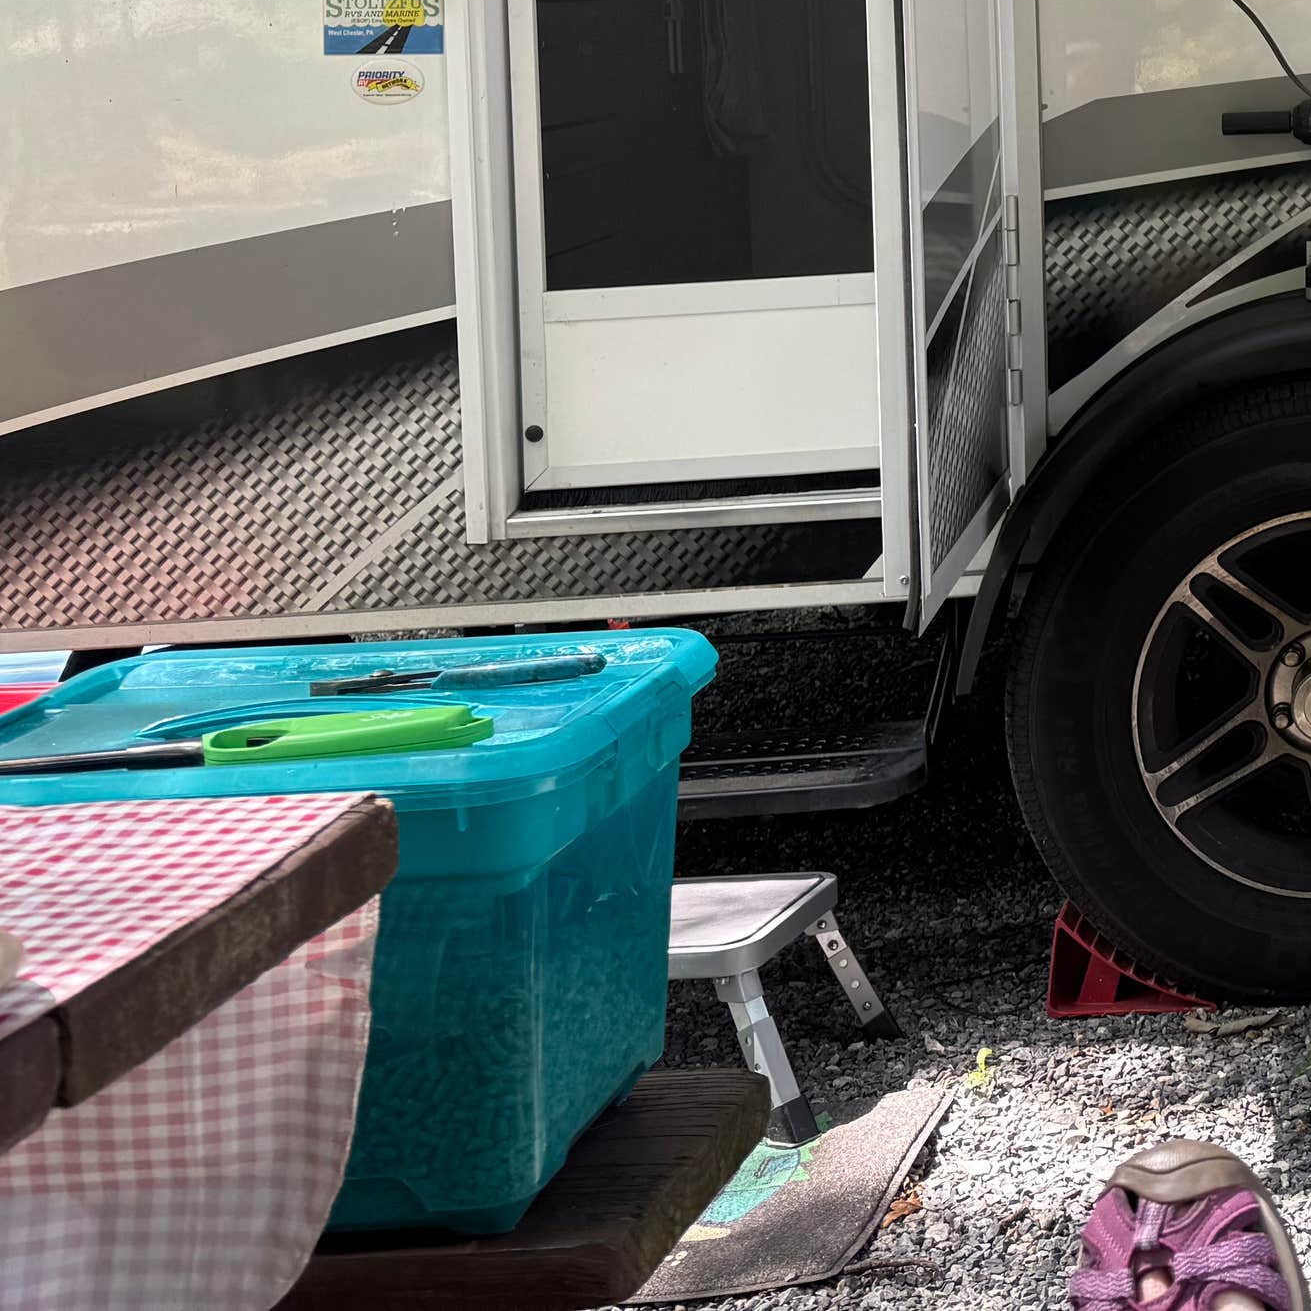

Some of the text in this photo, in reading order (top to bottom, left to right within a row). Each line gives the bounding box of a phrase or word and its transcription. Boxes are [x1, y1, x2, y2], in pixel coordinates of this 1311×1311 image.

[364, 10, 384, 18] AND
[385, 10, 420, 18] MARINE
[358, 71, 405, 79] PRIORITY
